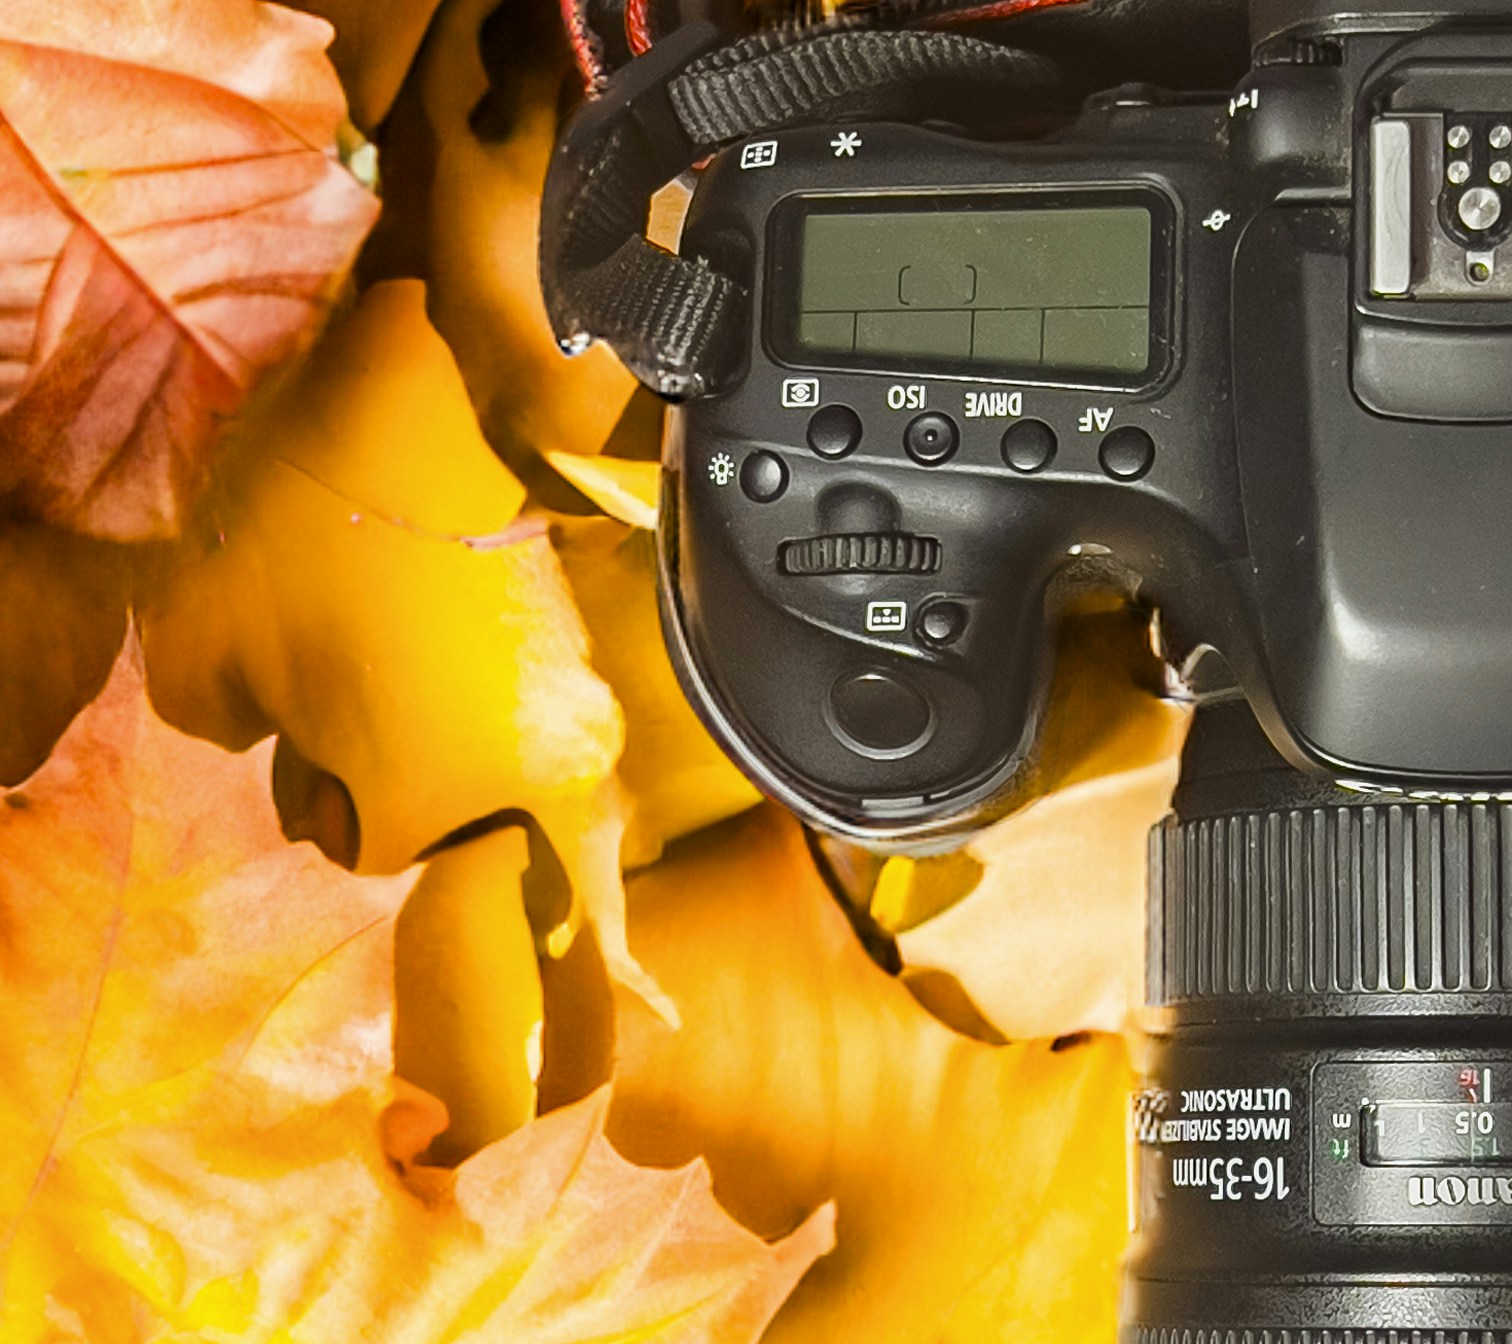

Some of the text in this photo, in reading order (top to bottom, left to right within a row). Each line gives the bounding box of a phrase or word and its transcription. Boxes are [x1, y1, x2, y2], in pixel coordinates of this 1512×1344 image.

[887, 384, 1114, 433] AF DRIVE ISO
[1180, 1087, 1291, 1113] ULTRASONIC
[1225, 1117, 1291, 1141] IMAGE
[1332, 1112, 1352, 1129] m
[1454, 1111, 1494, 1136] 0.5
[1172, 1156, 1291, 1201] 16-35mm
